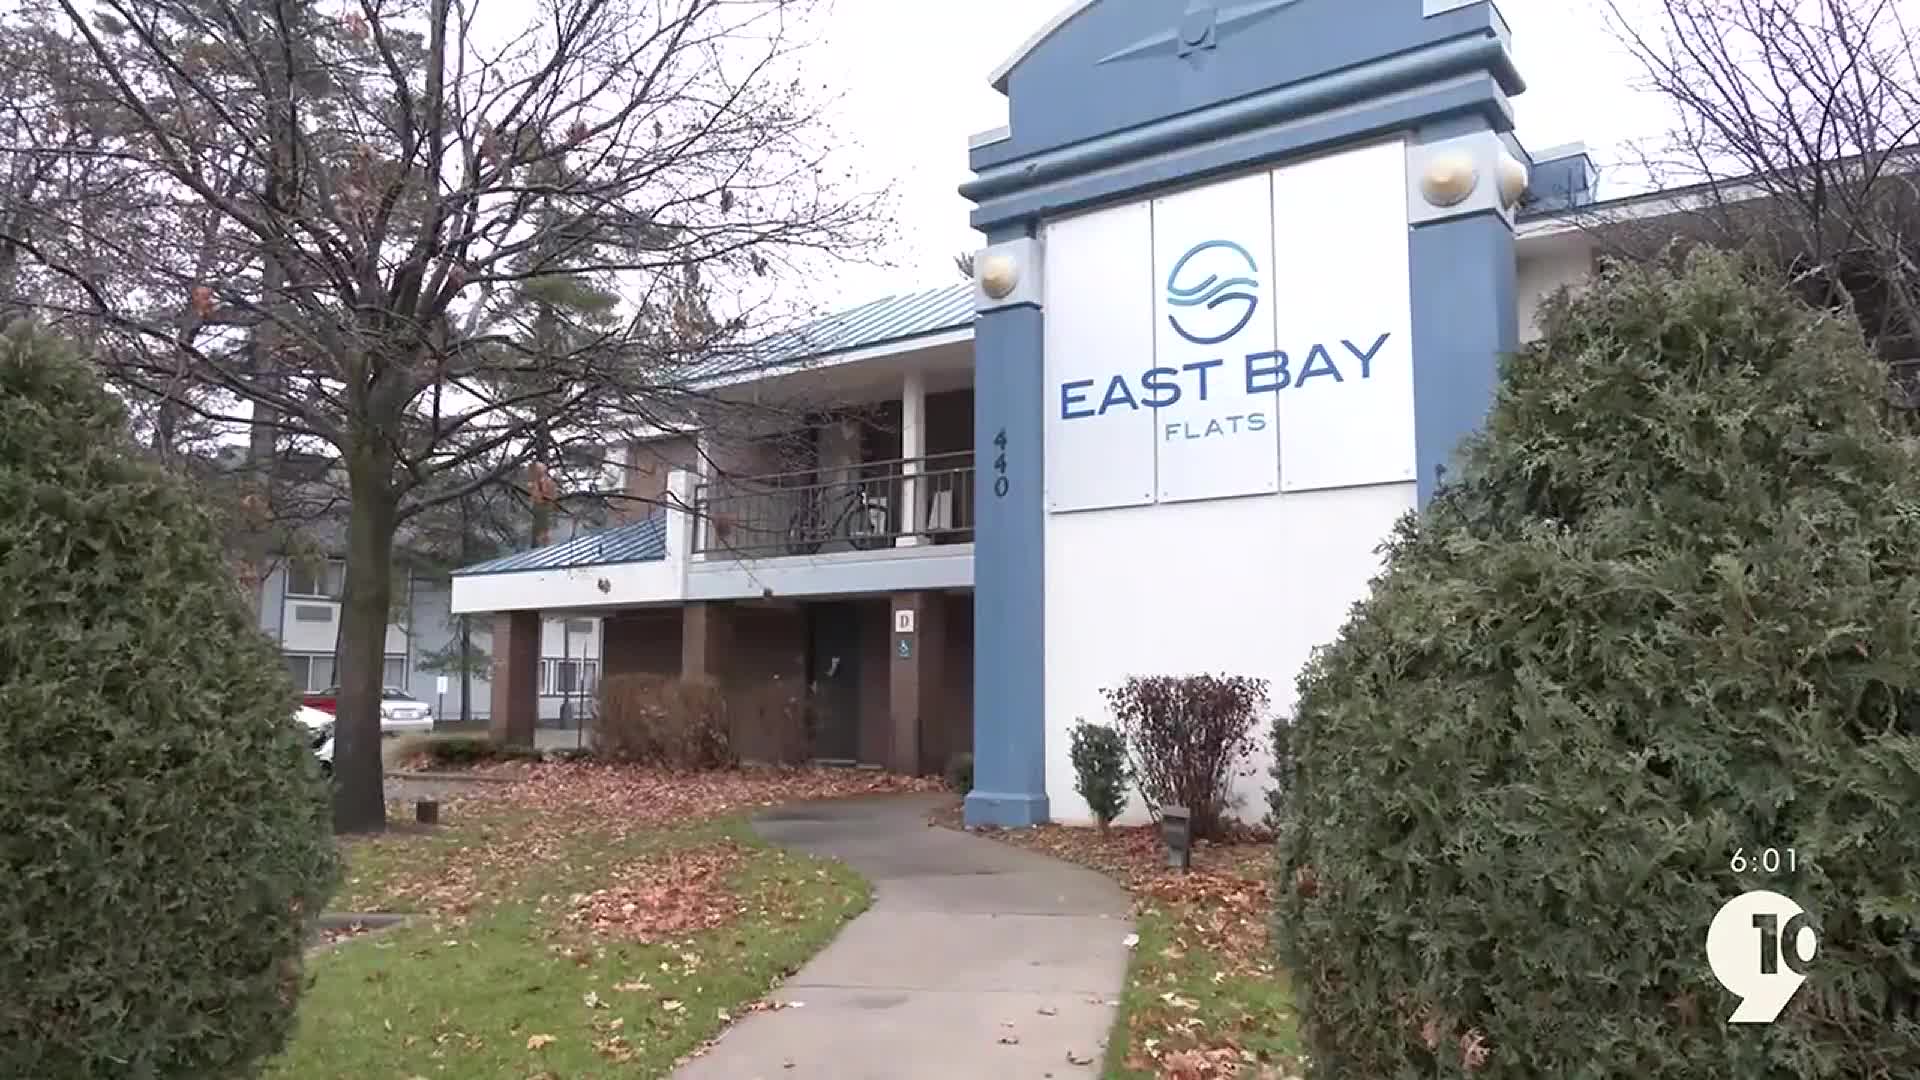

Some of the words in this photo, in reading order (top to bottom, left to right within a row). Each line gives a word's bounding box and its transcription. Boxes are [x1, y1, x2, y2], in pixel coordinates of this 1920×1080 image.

[1061, 359, 1224, 419] EAST
[1245, 332, 1391, 394] BAY
[1165, 412, 1267, 441] FLATS
[994, 428, 1009, 498] 440
[900, 615, 910, 629] D
